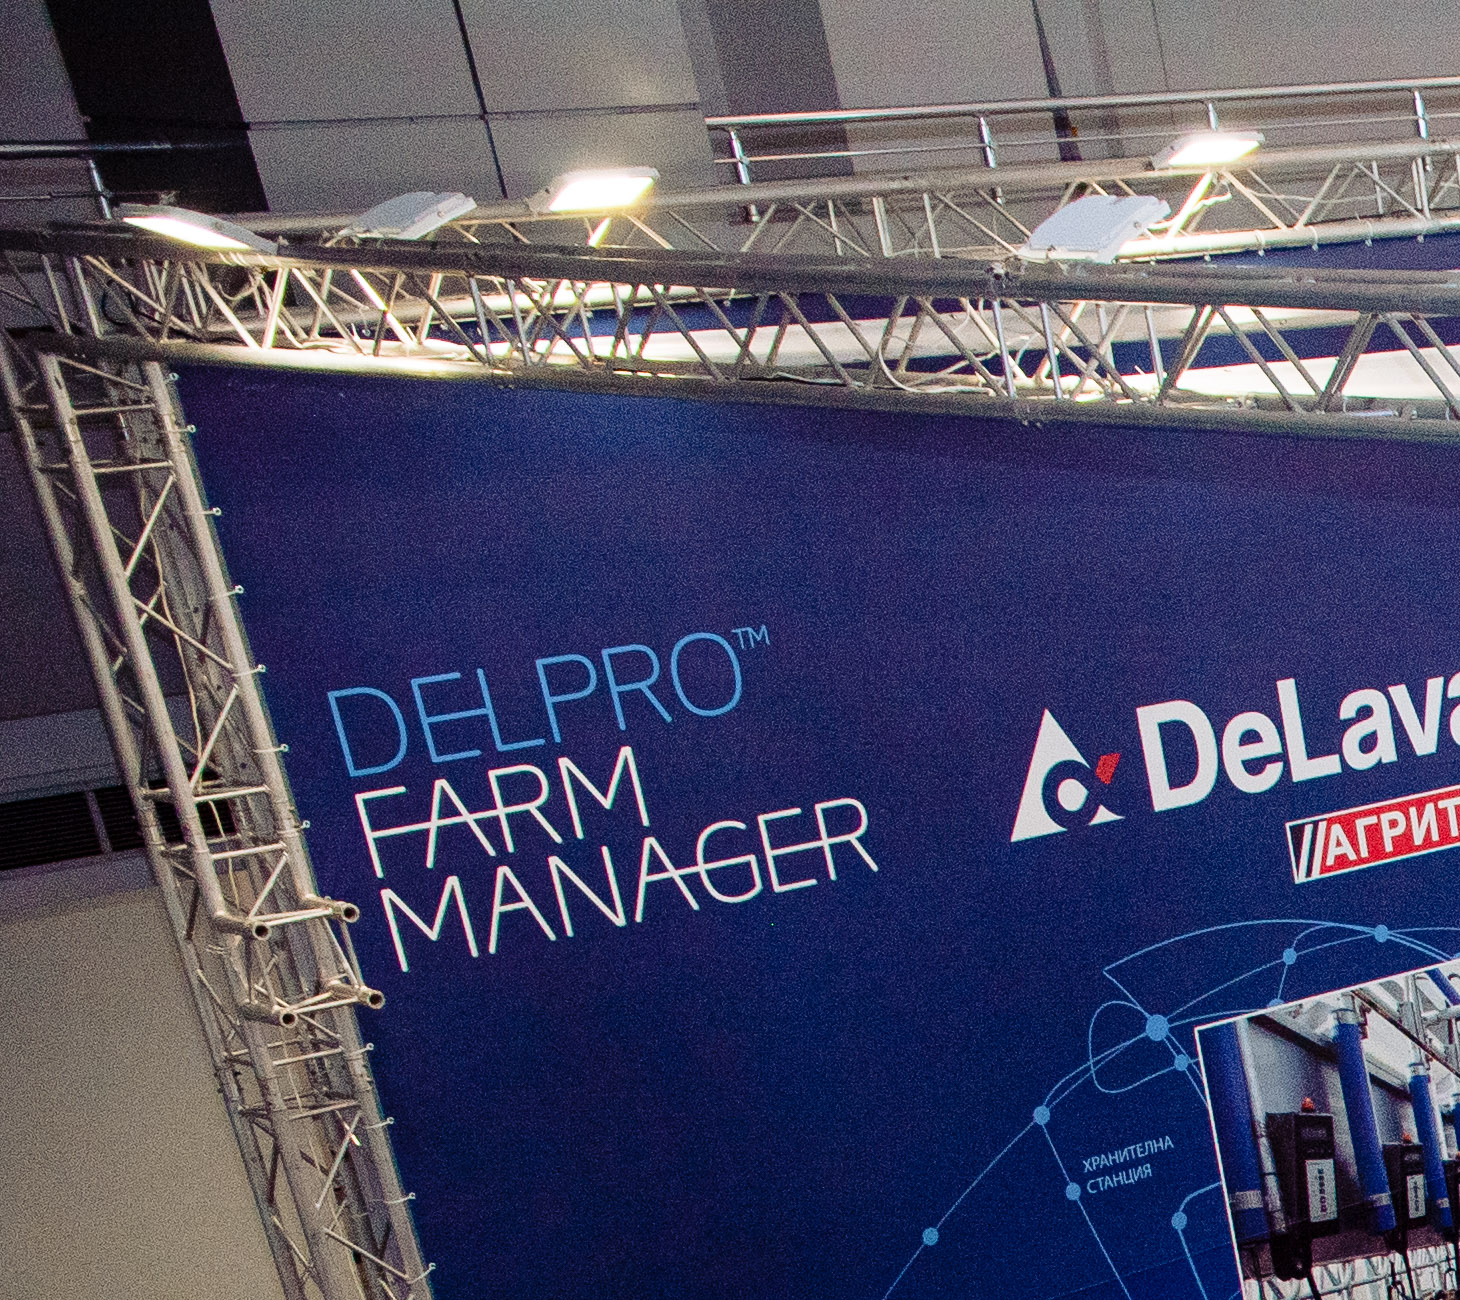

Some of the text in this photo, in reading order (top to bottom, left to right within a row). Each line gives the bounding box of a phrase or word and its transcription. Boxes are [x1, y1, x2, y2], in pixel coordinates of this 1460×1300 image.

[354, 746, 650, 878] FARM
[379, 796, 879, 973] MANAGER
[1082, 1134, 1175, 1174] ХРАНИТЕЛНА
[1086, 1164, 1154, 1195] СТАНЦИЯ
